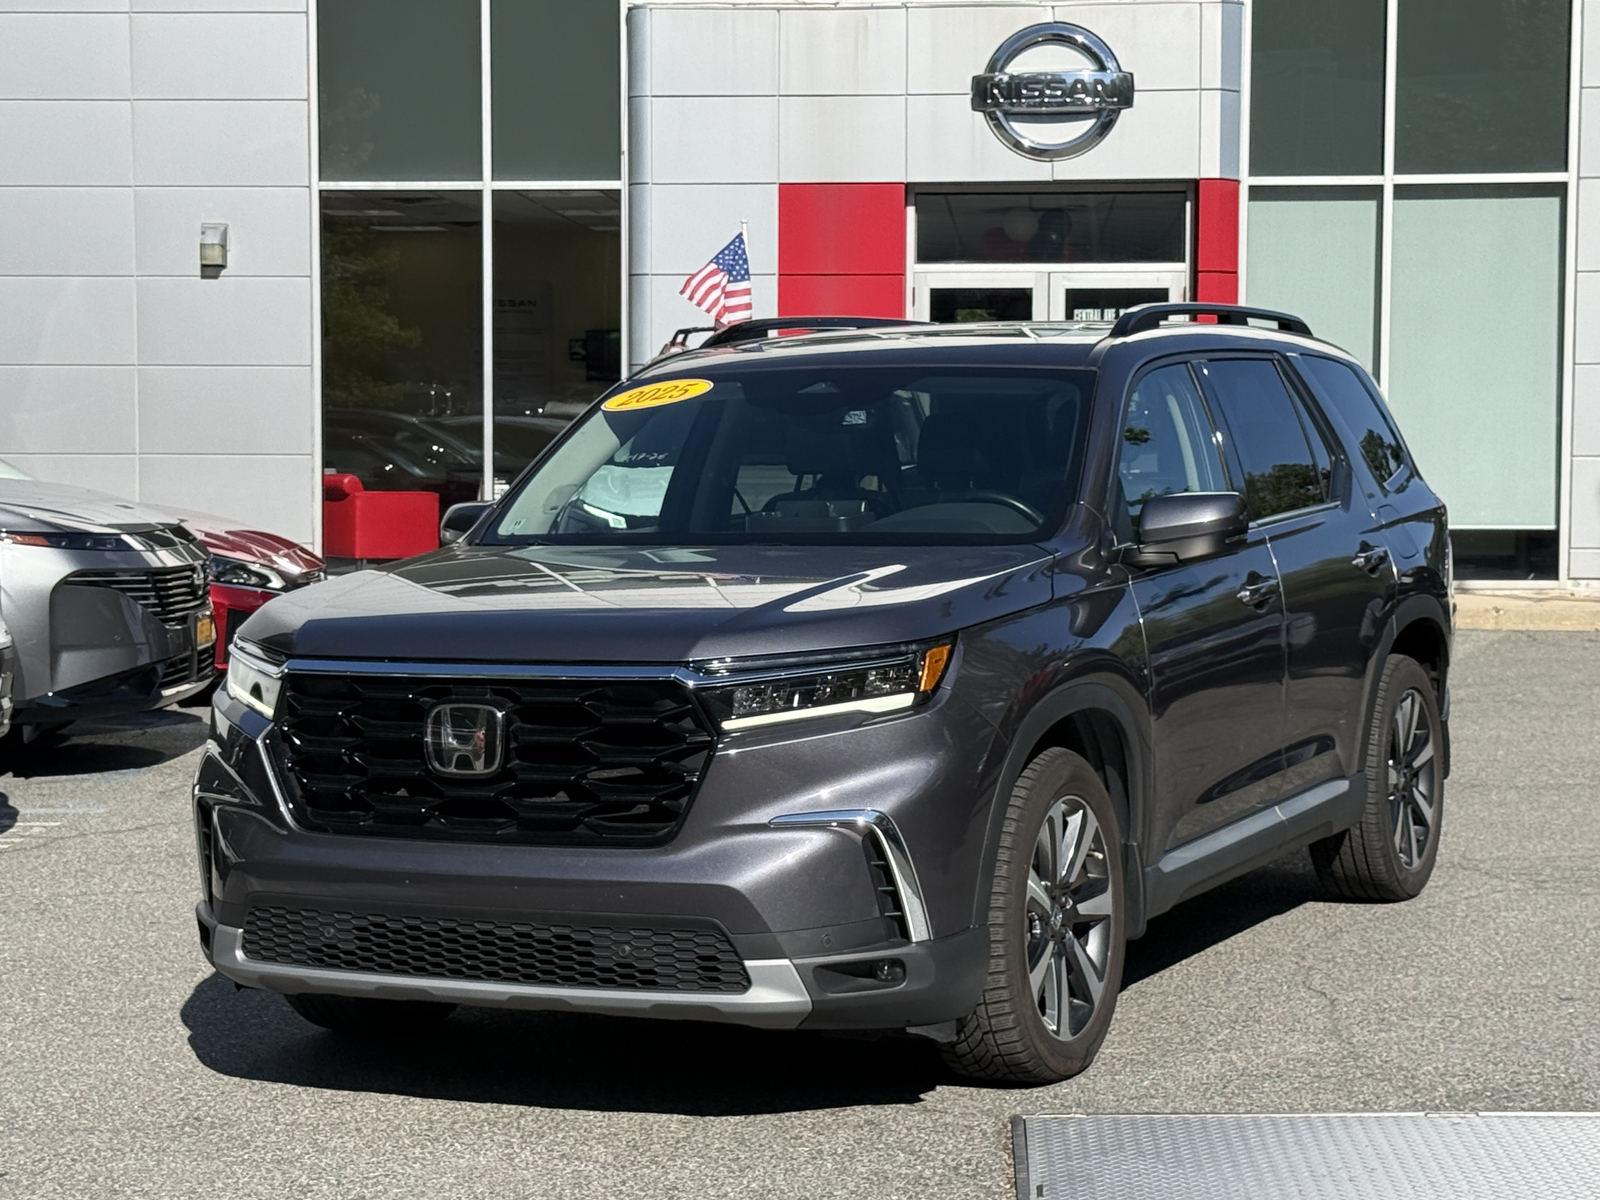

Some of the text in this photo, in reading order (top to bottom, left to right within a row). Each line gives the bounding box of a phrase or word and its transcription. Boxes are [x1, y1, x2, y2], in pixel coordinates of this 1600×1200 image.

[987, 78, 1118, 102] NISSAN
[498, 299, 537, 307] SSAN
[615, 382, 700, 408] 2025
